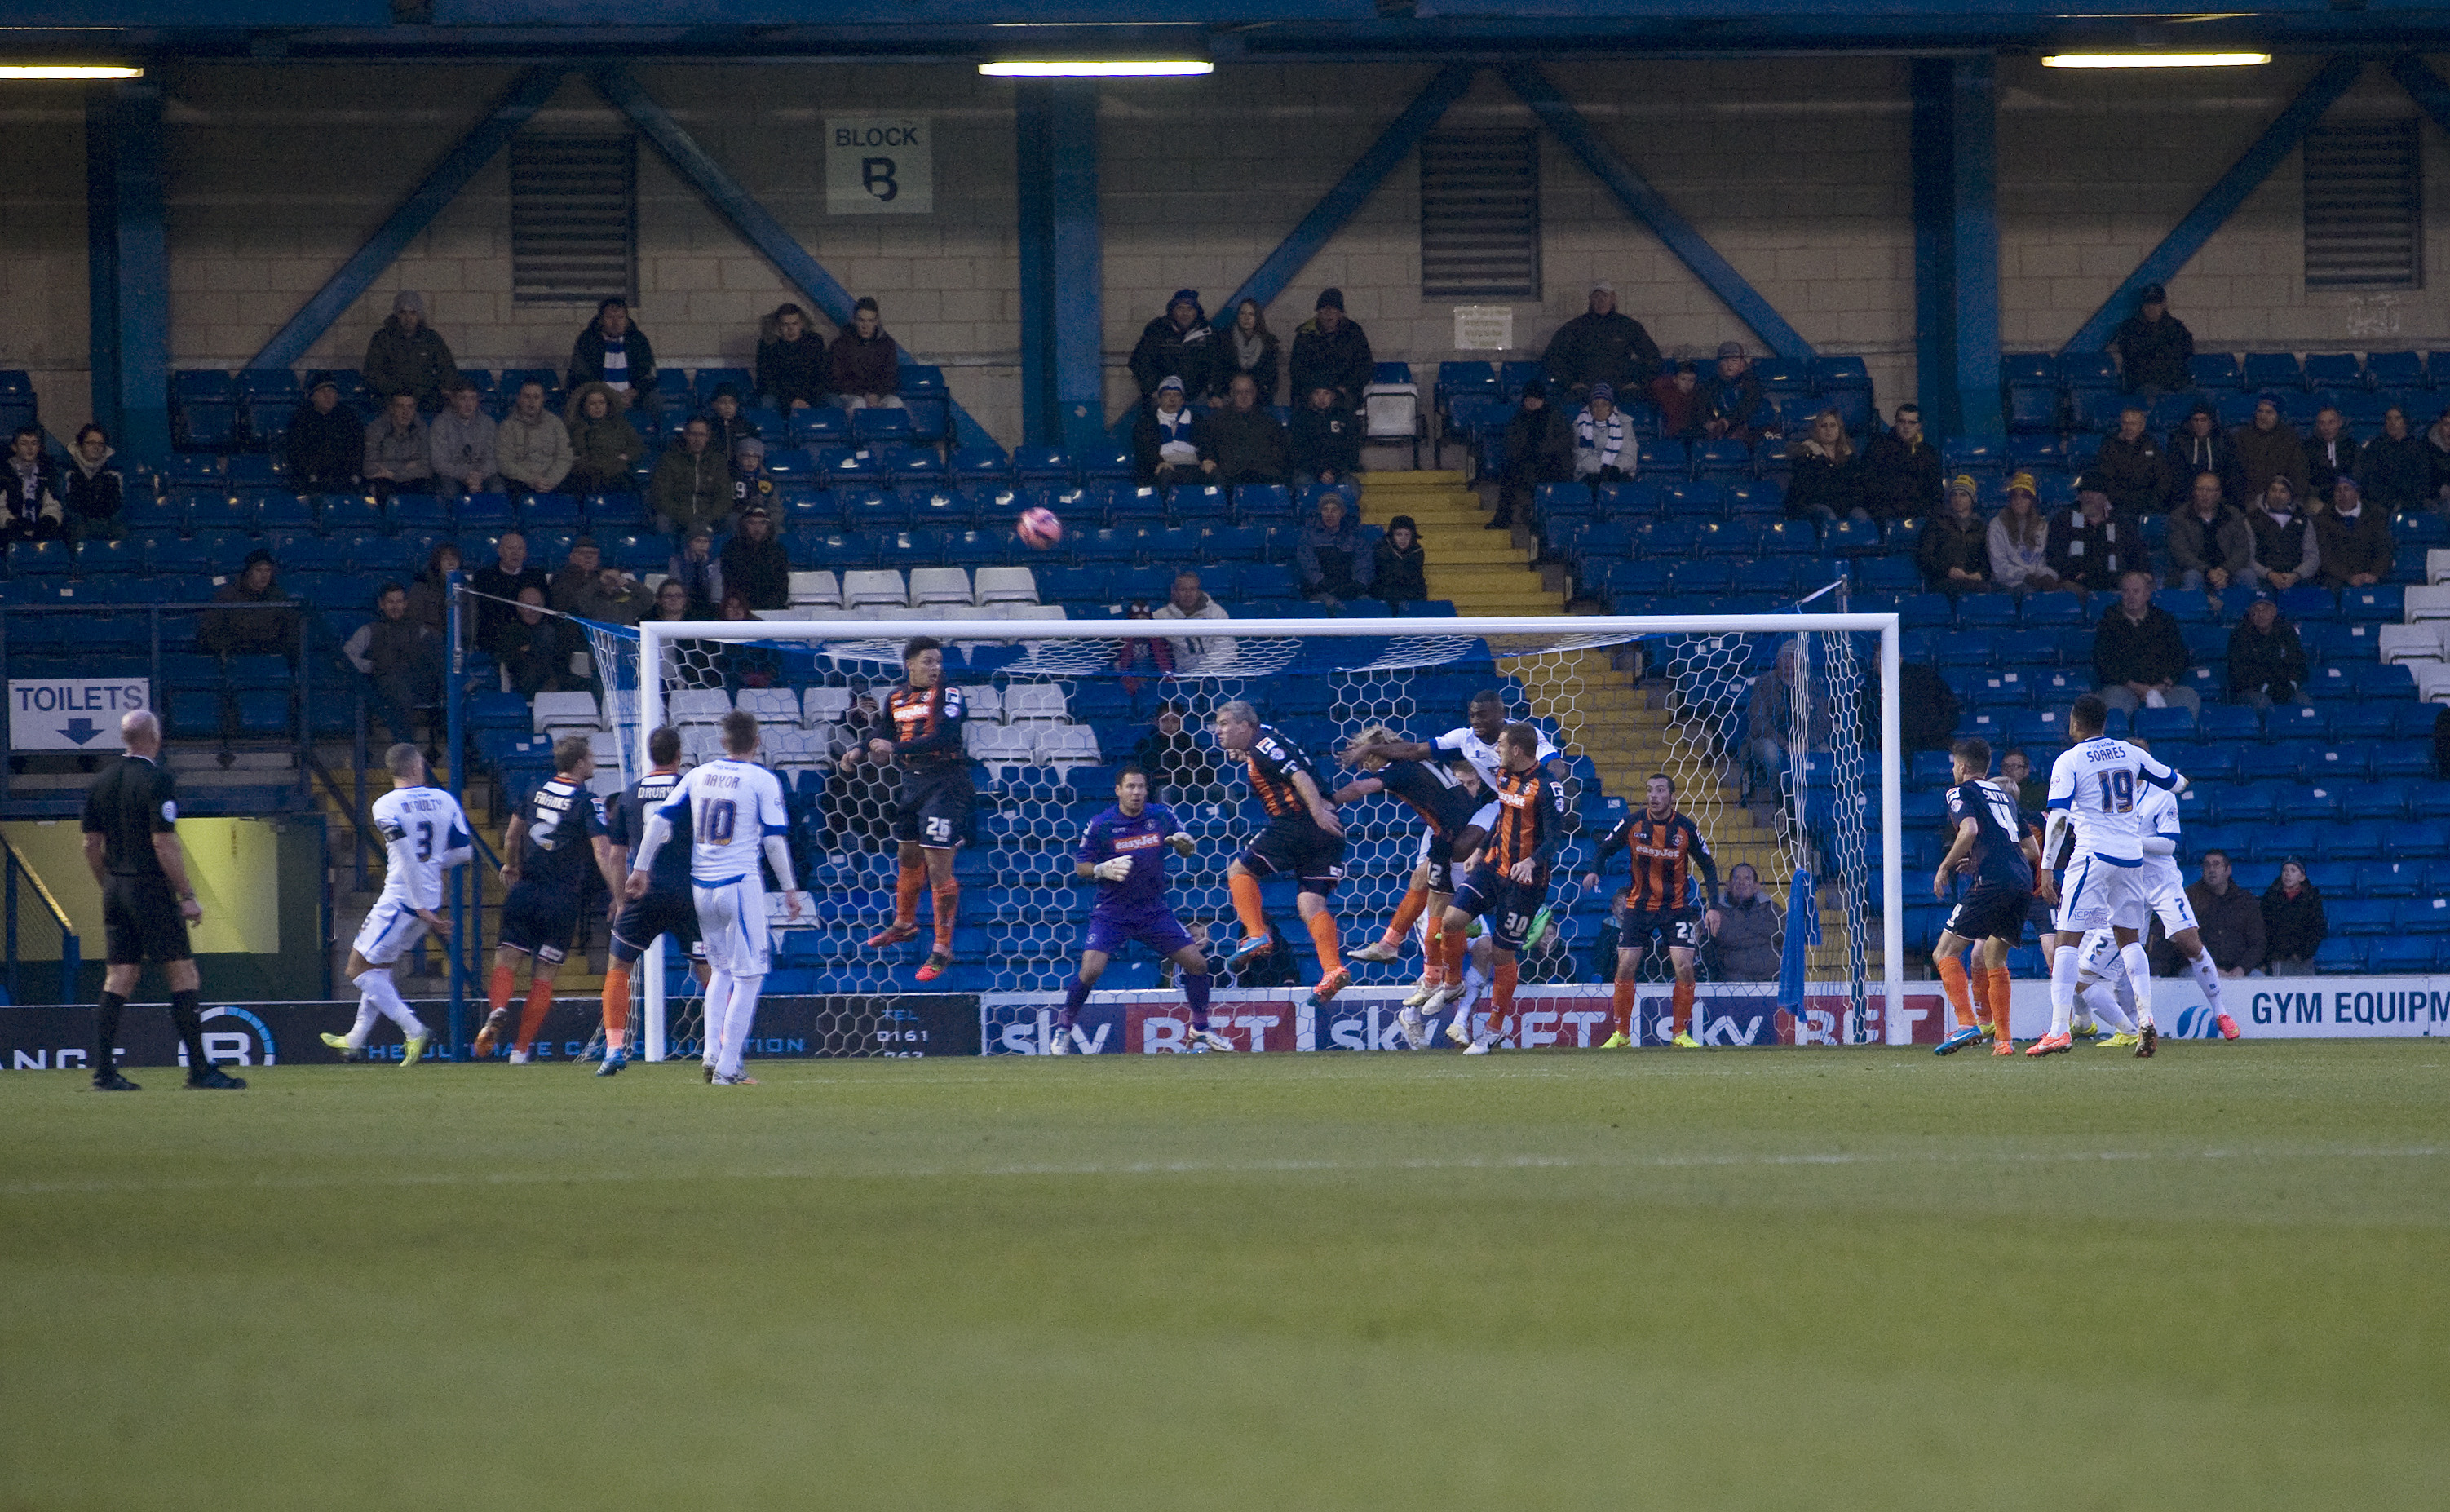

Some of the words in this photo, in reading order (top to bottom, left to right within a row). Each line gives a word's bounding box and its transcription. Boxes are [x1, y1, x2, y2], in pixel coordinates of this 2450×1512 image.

[835, 127, 919, 147] BLOCK
[862, 157, 899, 201] B
[15, 685, 143, 711] TOILETS
[2086, 746, 2126, 763] SOARES
[637, 785, 674, 798] DRURY
[704, 773, 741, 789] MAYOR
[2098, 769, 2134, 814] 19
[533, 790, 573, 811] FRANKS
[1983, 789, 2010, 803] SMITH
[528, 807, 562, 851] 2
[696, 797, 737, 846] 10
[926, 816, 952, 837] 26
[1988, 802, 2020, 843] 4
[416, 821, 434, 862] 3
[1115, 834, 1159, 851] easyJet
[1635, 844, 1680, 858] easyJet
[1504, 911, 1529, 932] 30
[1950, 903, 1963, 922] 4
[882, 1010, 918, 1021] TEL
[2252, 992, 2322, 1024] GYM
[2335, 991, 2450, 1026] EQUIPM
[876, 1030, 929, 1042] 0161
